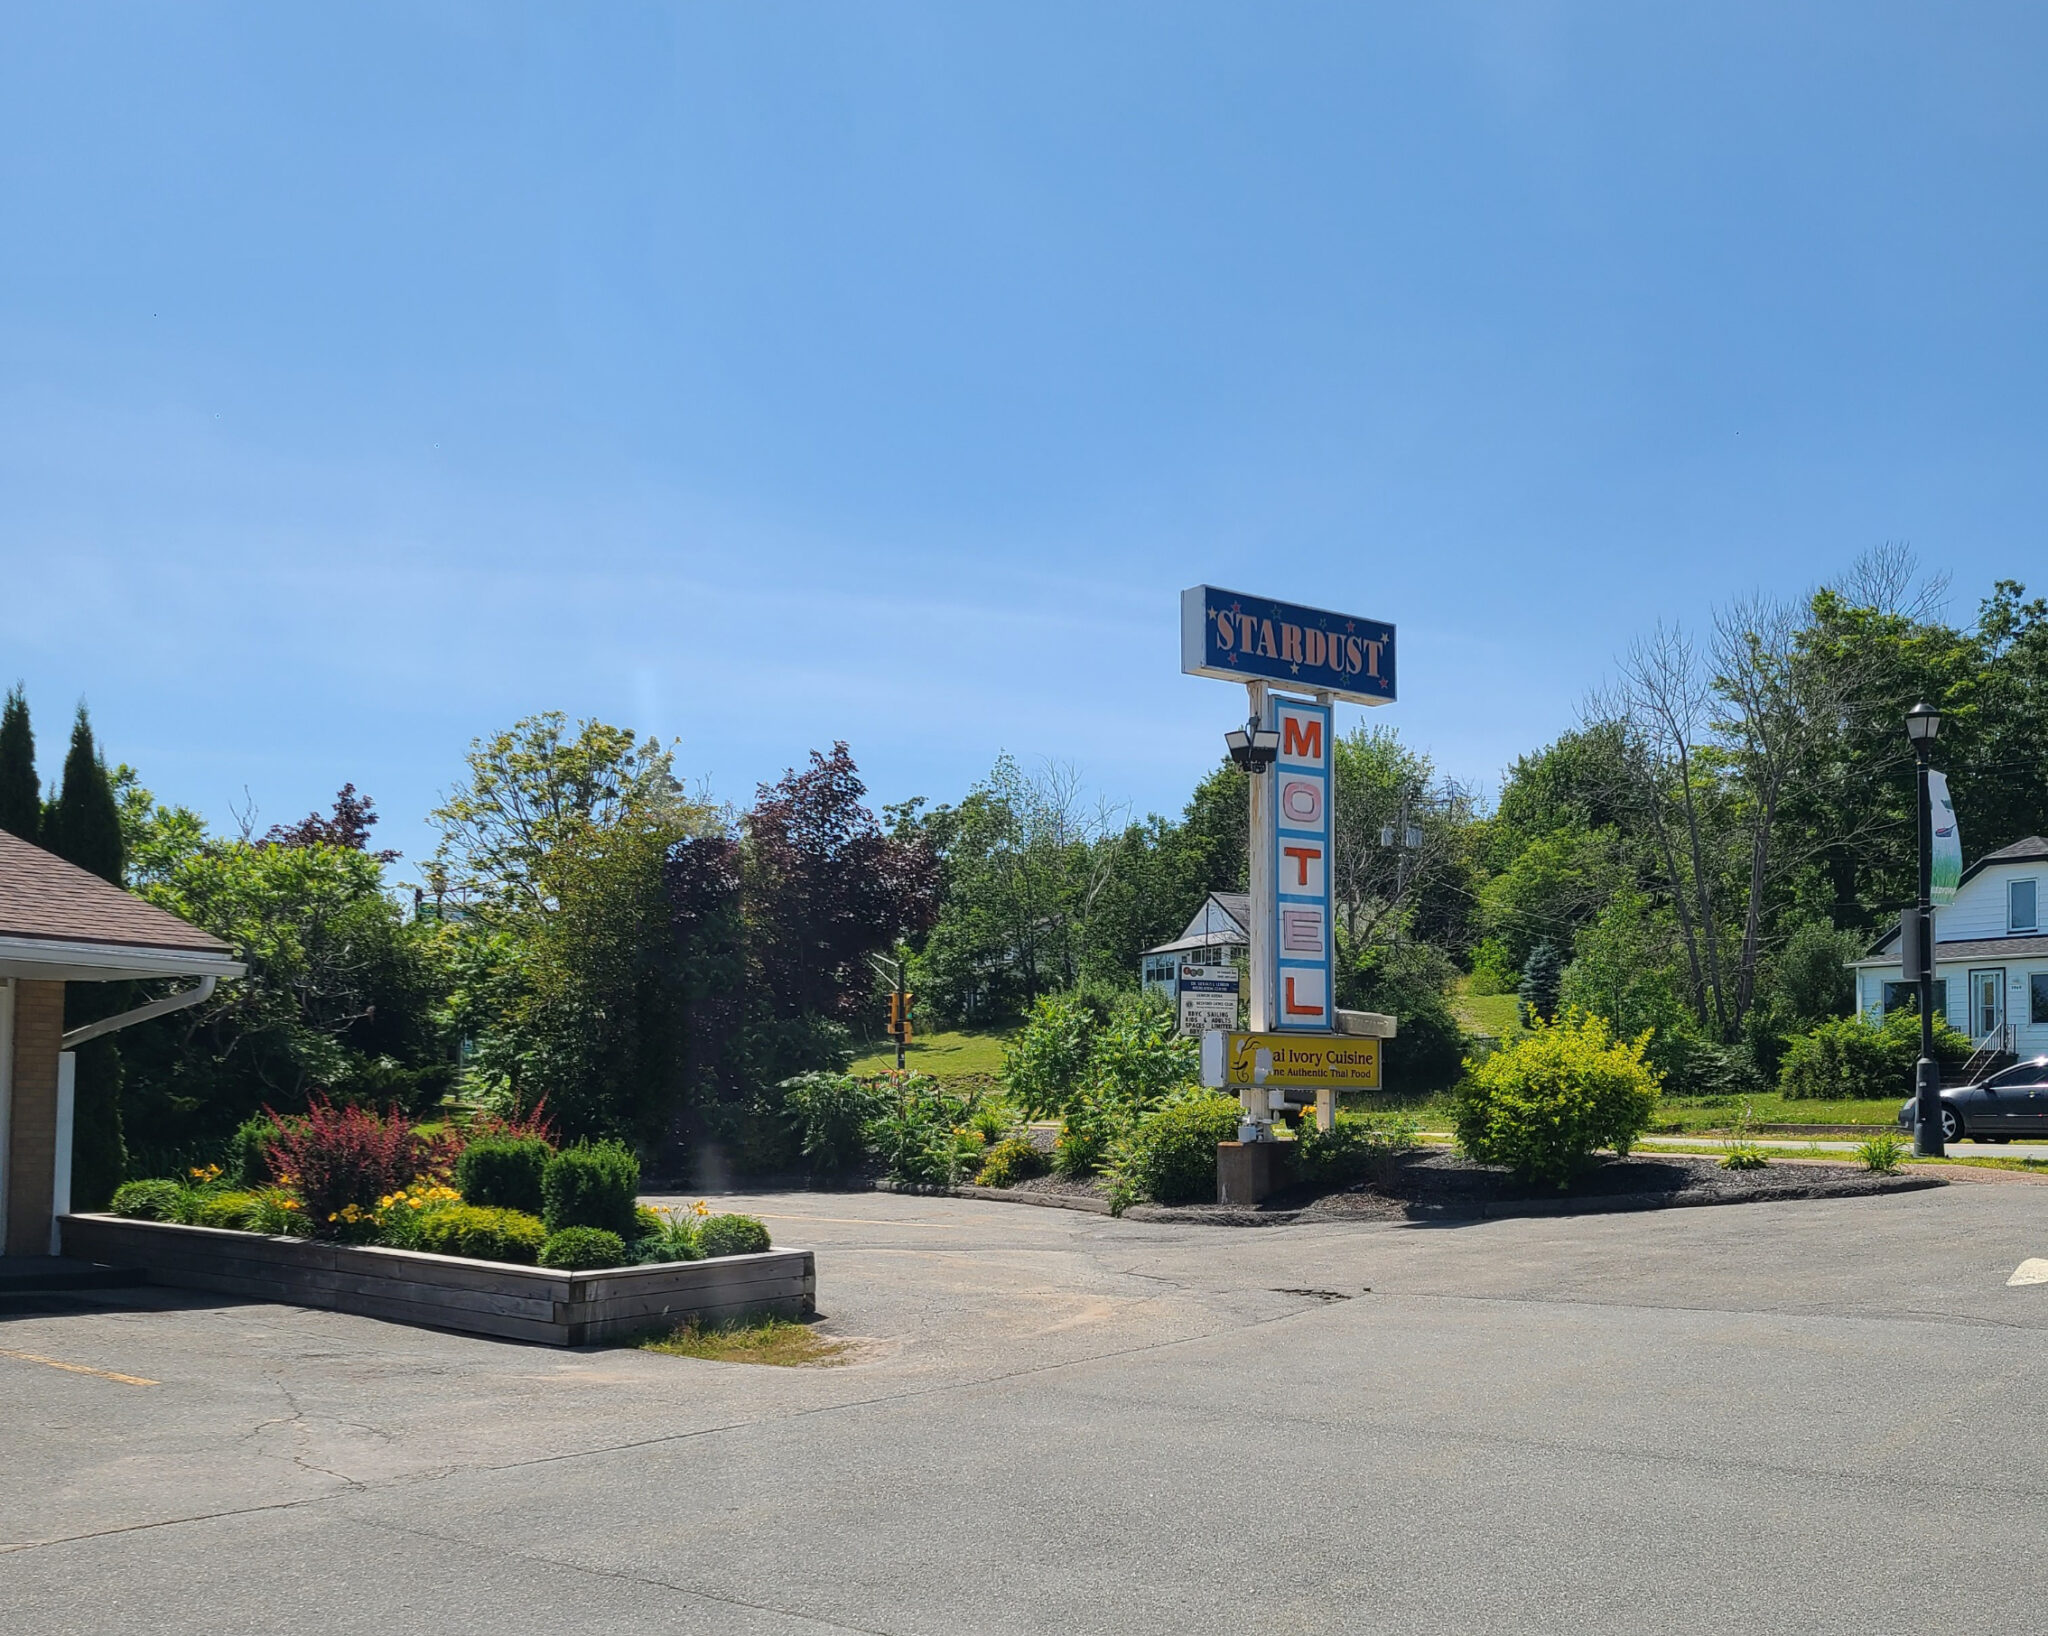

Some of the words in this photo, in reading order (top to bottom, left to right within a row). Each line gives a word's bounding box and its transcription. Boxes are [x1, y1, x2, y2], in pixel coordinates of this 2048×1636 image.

[1216, 609, 1383, 678] STARDUST
[1282, 716, 1323, 1015] MOTEL
[1273, 1048, 1285, 1063] ai
[1289, 1049, 1322, 1067] Ivory
[1326, 1050, 1373, 1065] Cuisine
[1287, 1068, 1328, 1078] Authentic
[1330, 1069, 1348, 1078] Thai
[1351, 1069, 1371, 1079] Food
